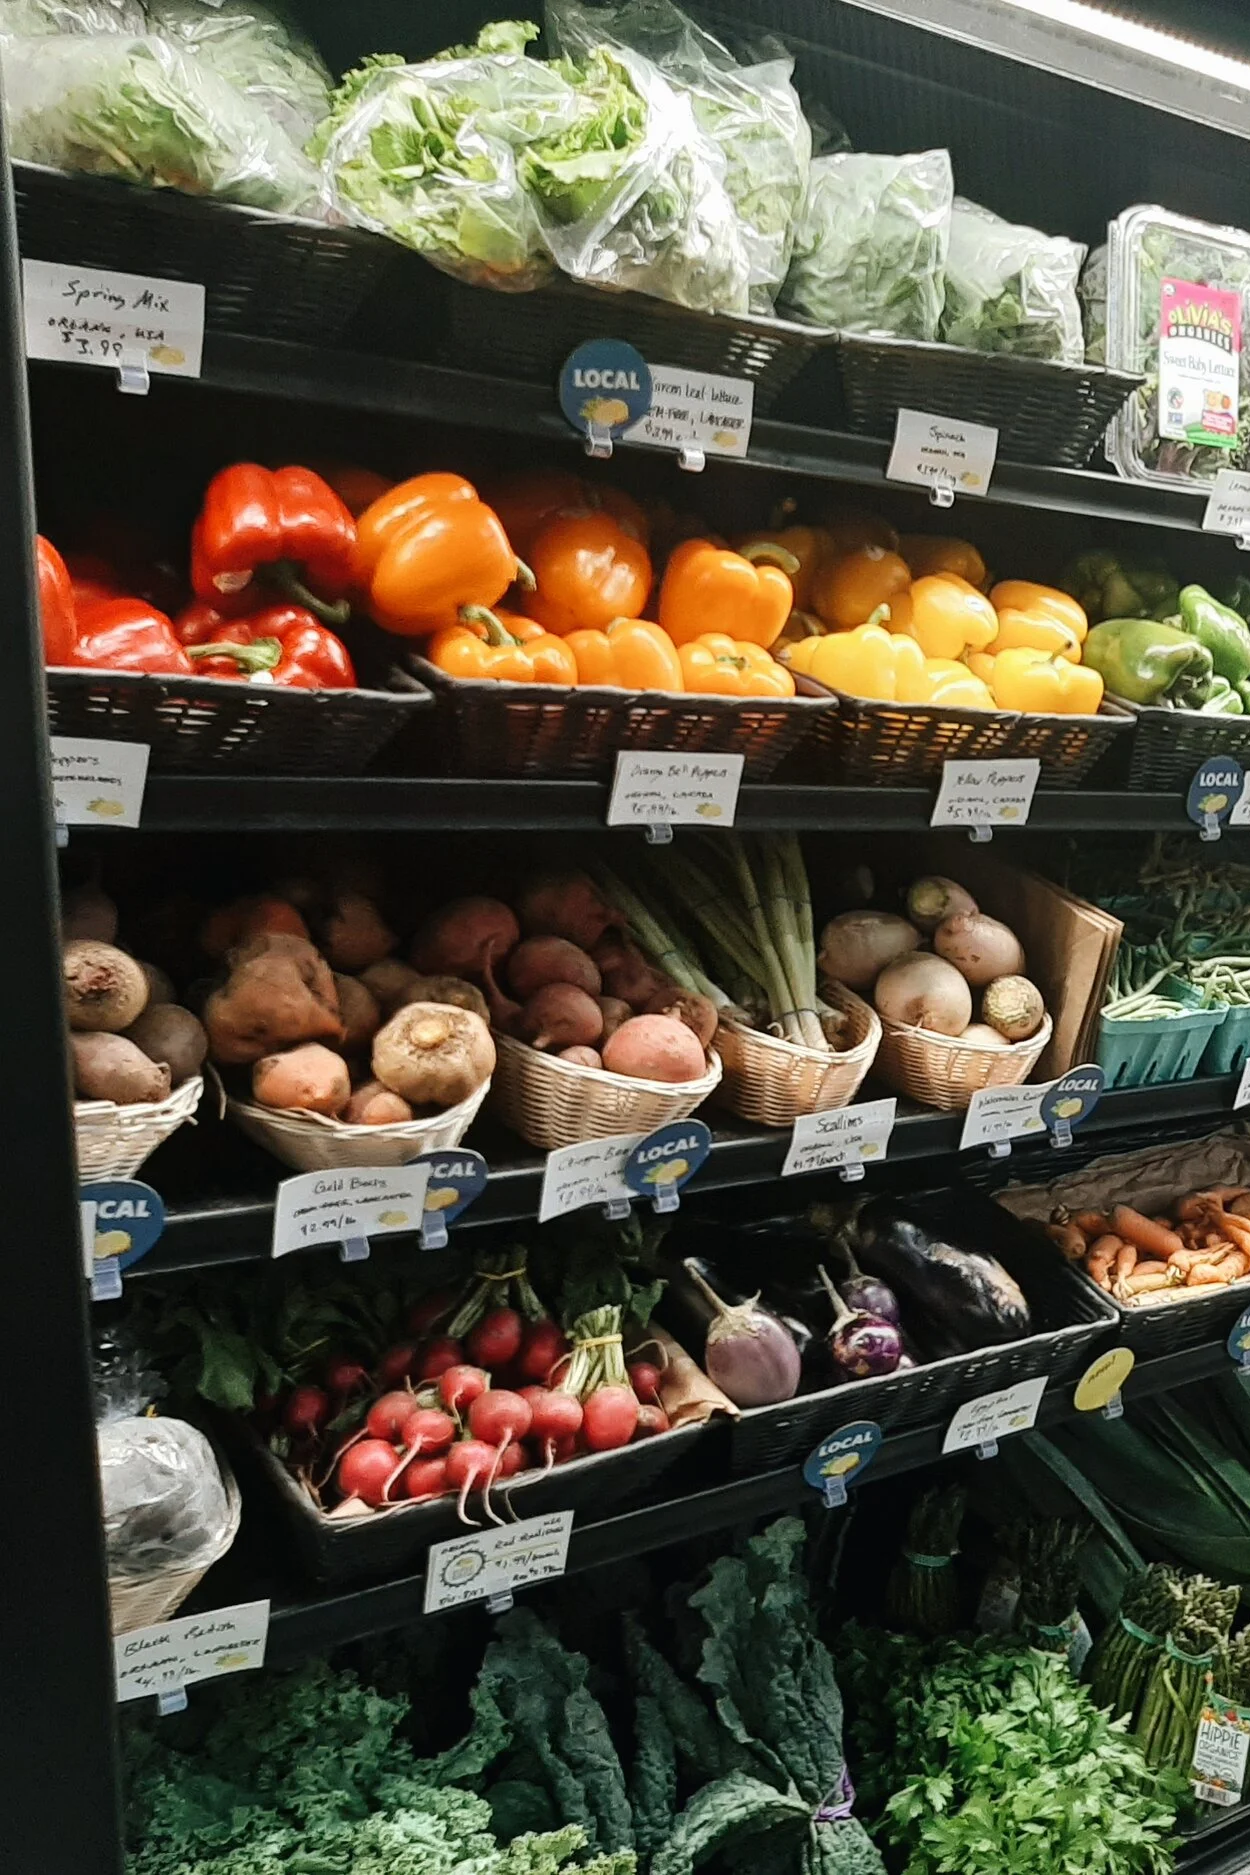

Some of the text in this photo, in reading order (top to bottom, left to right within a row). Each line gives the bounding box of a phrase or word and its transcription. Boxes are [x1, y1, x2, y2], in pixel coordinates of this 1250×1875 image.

[62, 280, 125, 310] Spring
[1163, 352, 1236, 378] Sweet Baby Lettuce
[573, 368, 640, 391] LOCAL
[1199, 772, 1239, 786] LOCAL
[1057, 1079, 1099, 1092] LOCAL
[637, 1134, 700, 1163] LOCAL
[427, 1161, 477, 1178] CAL
[314, 1175, 388, 1194] Gold Beets
[94, 1198, 151, 1219] CAL
[818, 1431, 874, 1458] LOCAL
